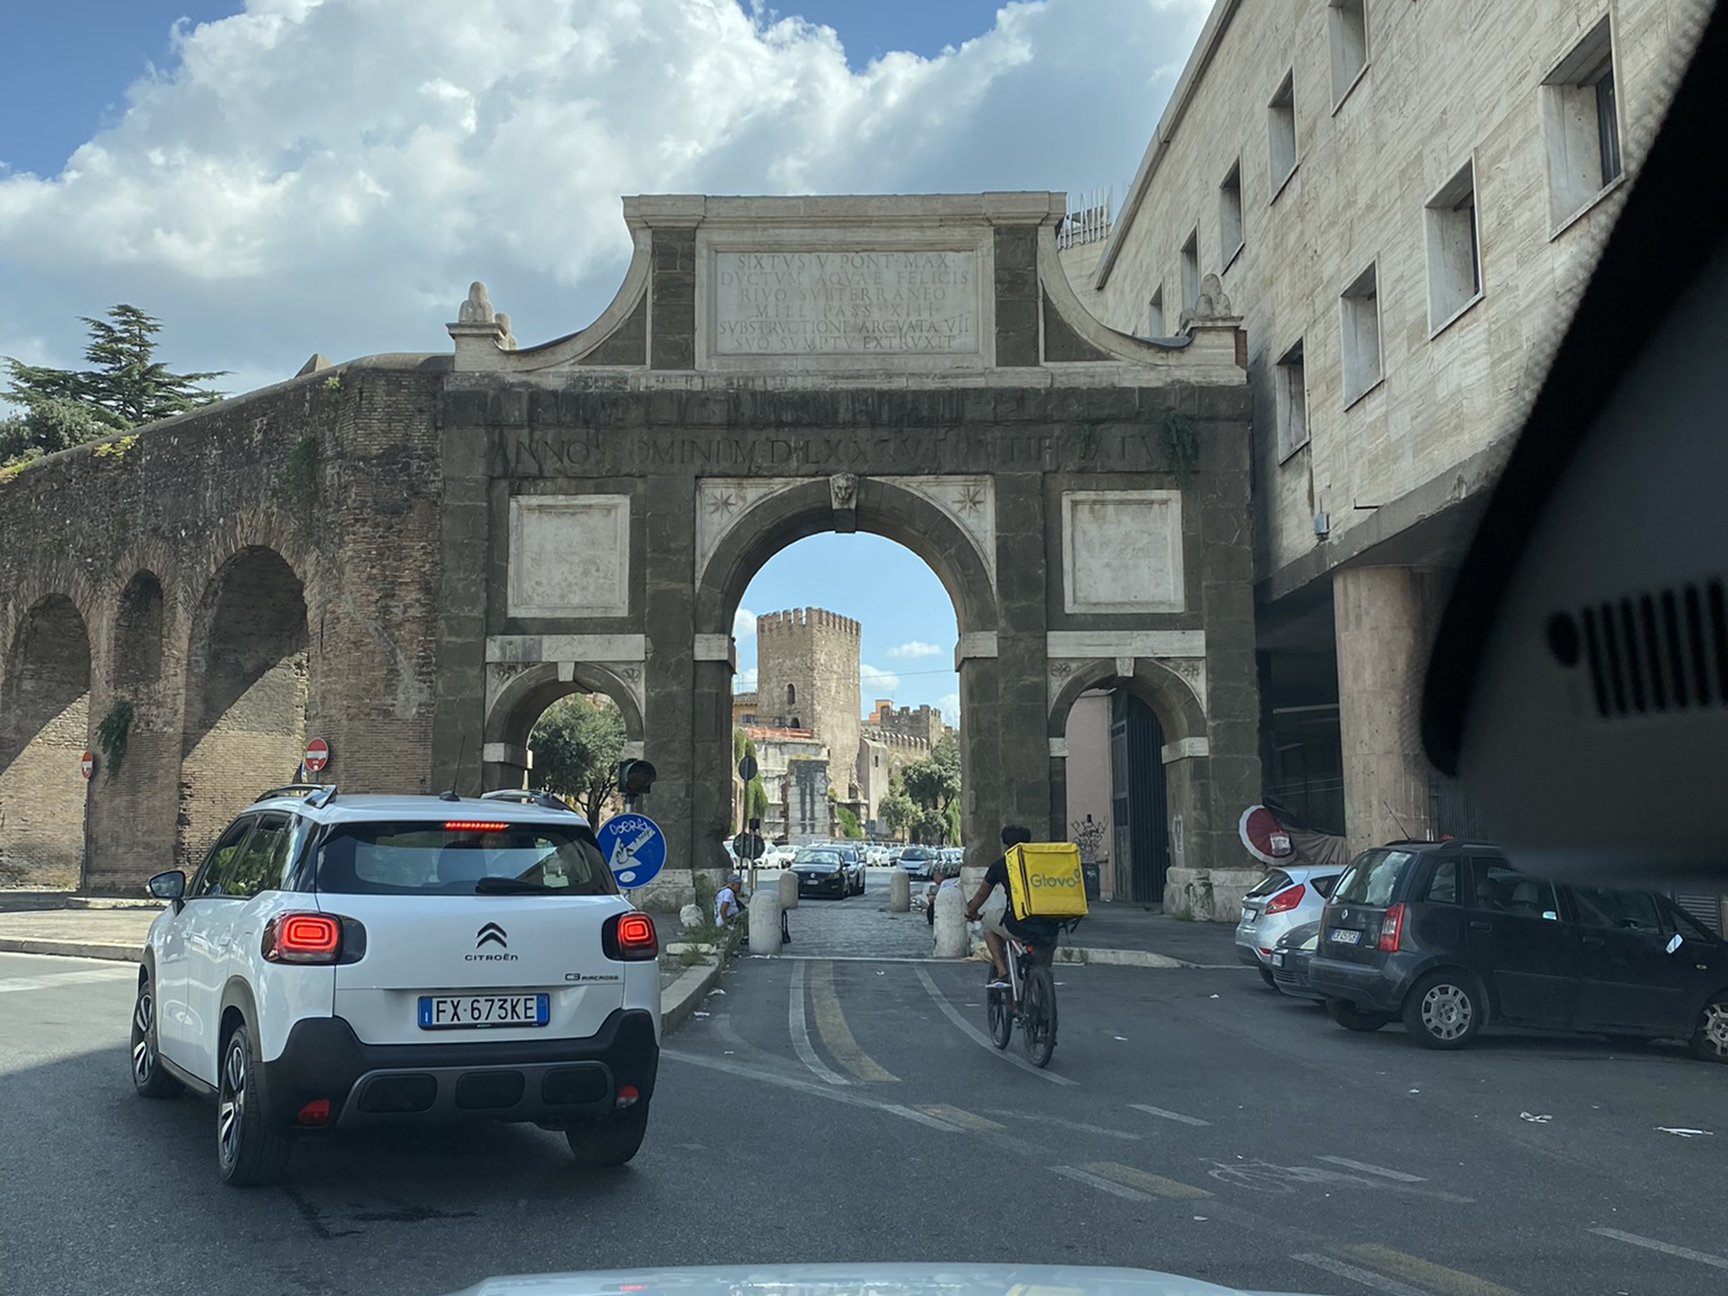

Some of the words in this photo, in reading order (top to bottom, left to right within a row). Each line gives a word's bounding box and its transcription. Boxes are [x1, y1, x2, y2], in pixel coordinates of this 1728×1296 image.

[737, 254, 806, 269] SIXTVS
[840, 254, 894, 269] PONT
[721, 271, 801, 286] DVCTVM
[816, 271, 882, 287] AQVAE
[897, 270, 969, 285] FELICIS
[741, 288, 788, 302] RIVO
[799, 286, 946, 302] SVBTERRANEO
[718, 320, 851, 335] SVBSTRVCTIONE
[735, 336, 770, 350] SVO
[780, 336, 856, 351] SVMPTV
[863, 335, 955, 350] EXTRVXIT
[1030, 873, 1077, 888] Glovo
